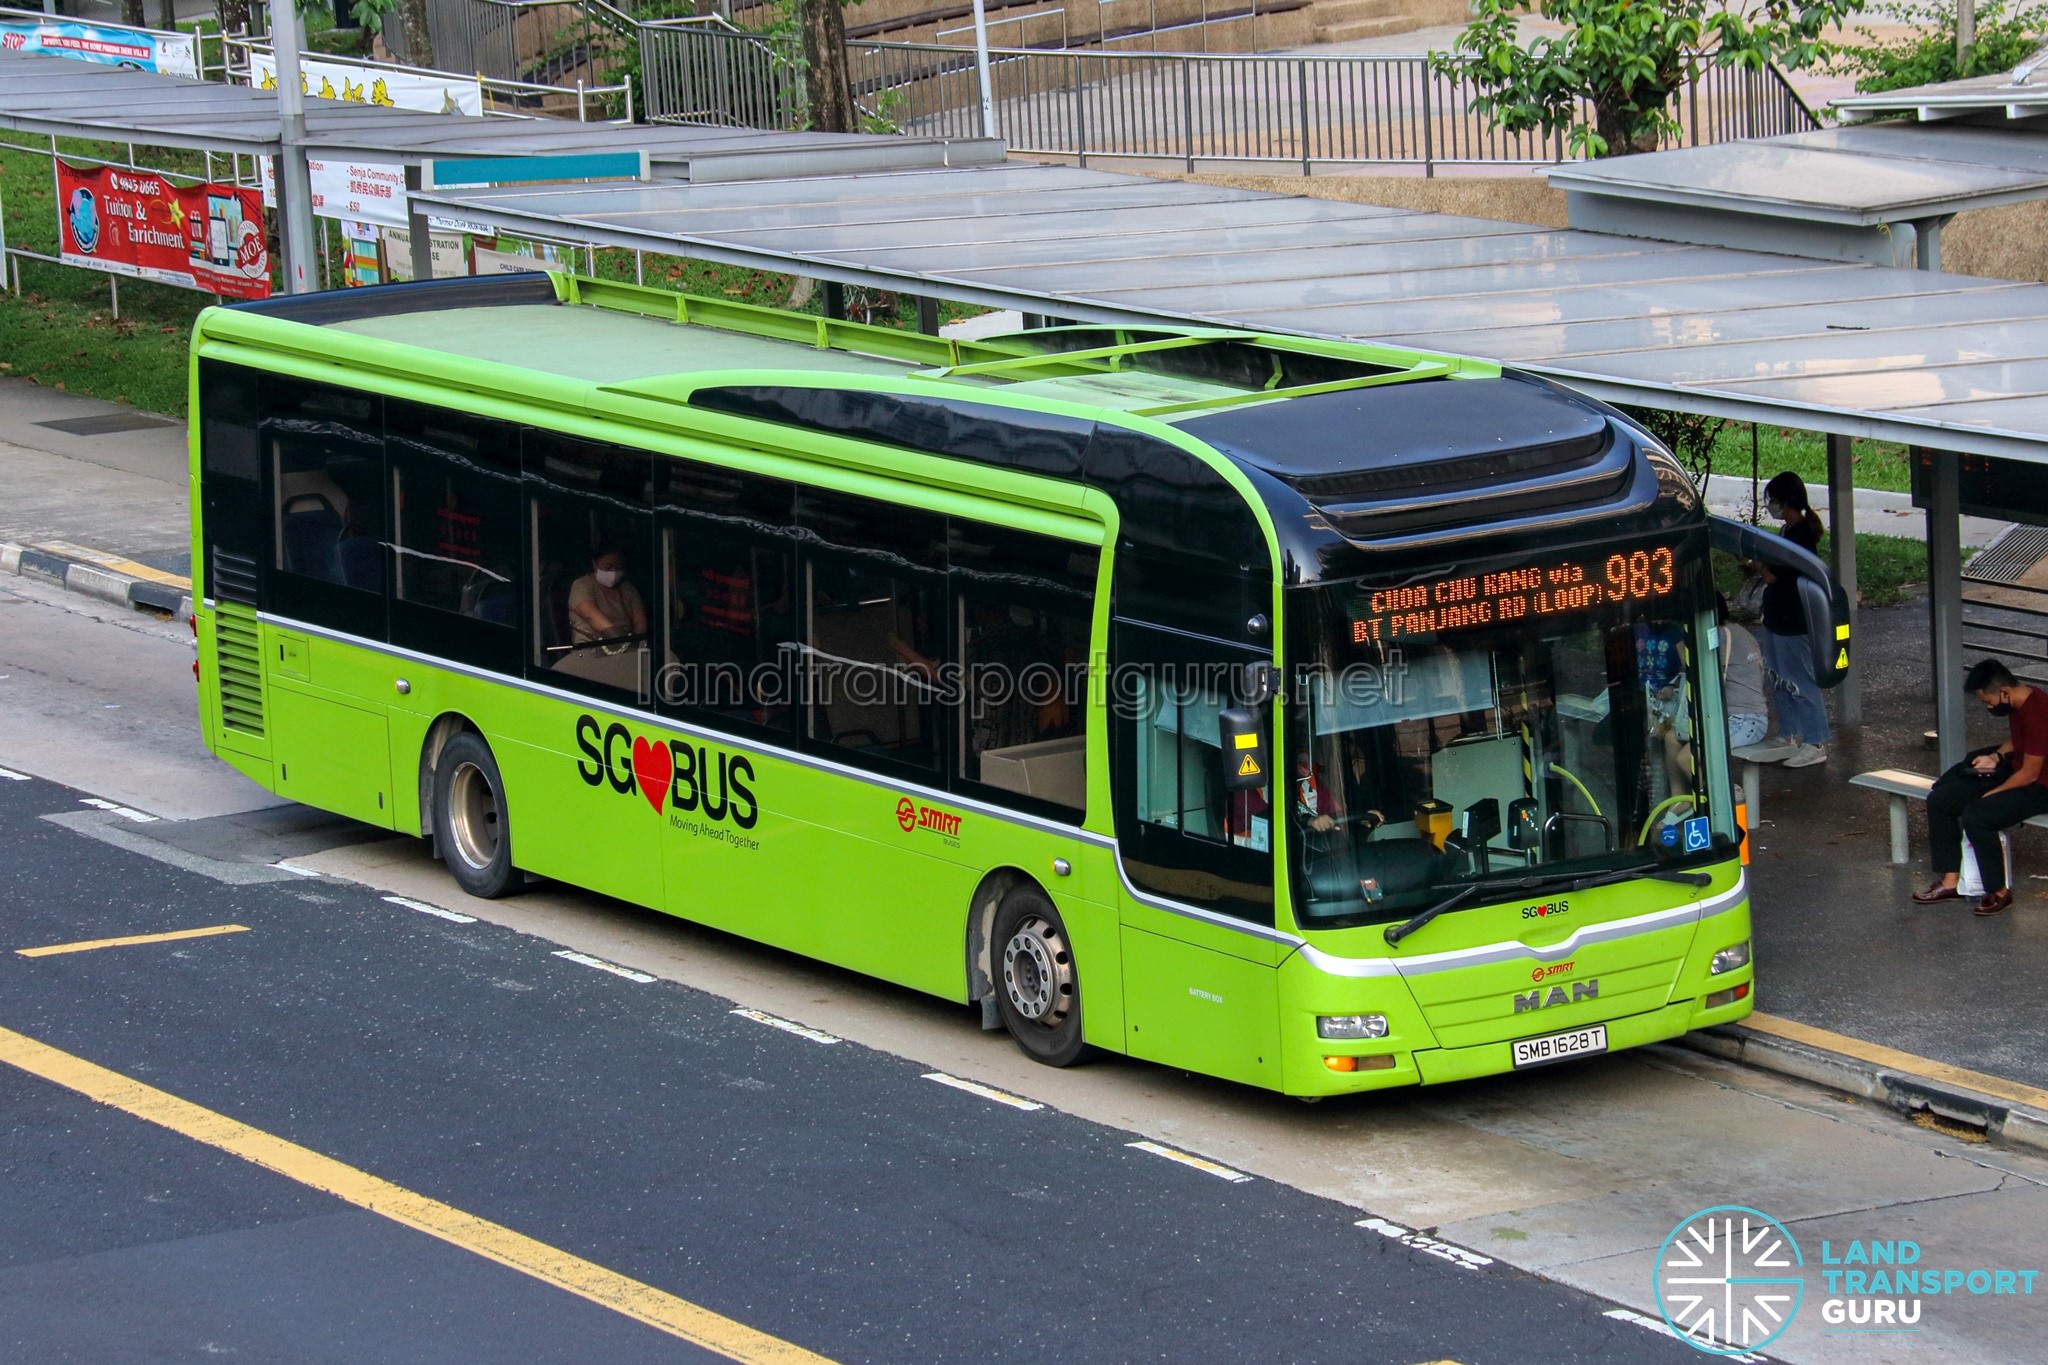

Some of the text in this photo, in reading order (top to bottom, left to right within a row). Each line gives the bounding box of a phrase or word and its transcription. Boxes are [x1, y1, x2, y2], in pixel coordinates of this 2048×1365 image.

[2, 32, 26, 50] STOP
[140, 180, 160, 195] 0665
[350, 166, 366, 179] Senja
[367, 168, 398, 185] Community
[103, 195, 147, 221] Tuition &
[350, 201, 360, 213] $50
[128, 223, 185, 250] Enrichment
[389, 229, 410, 243] ANNUA
[429, 240, 459, 250] STRATION
[240, 236, 263, 264] MOE
[1371, 562, 1583, 613] CHOA CHU KANG via
[1606, 547, 1673, 601] 983
[1353, 583, 1602, 642] BT PANJANG RD (LOOP)
[669, 814, 759, 851] Moving Ahead Together
[917, 806, 962, 836] SMRT
[1546, 961, 1575, 976] SMRT
[1513, 978, 1599, 1014] MAN
[1518, 1029, 1600, 1061] SMB1628T
